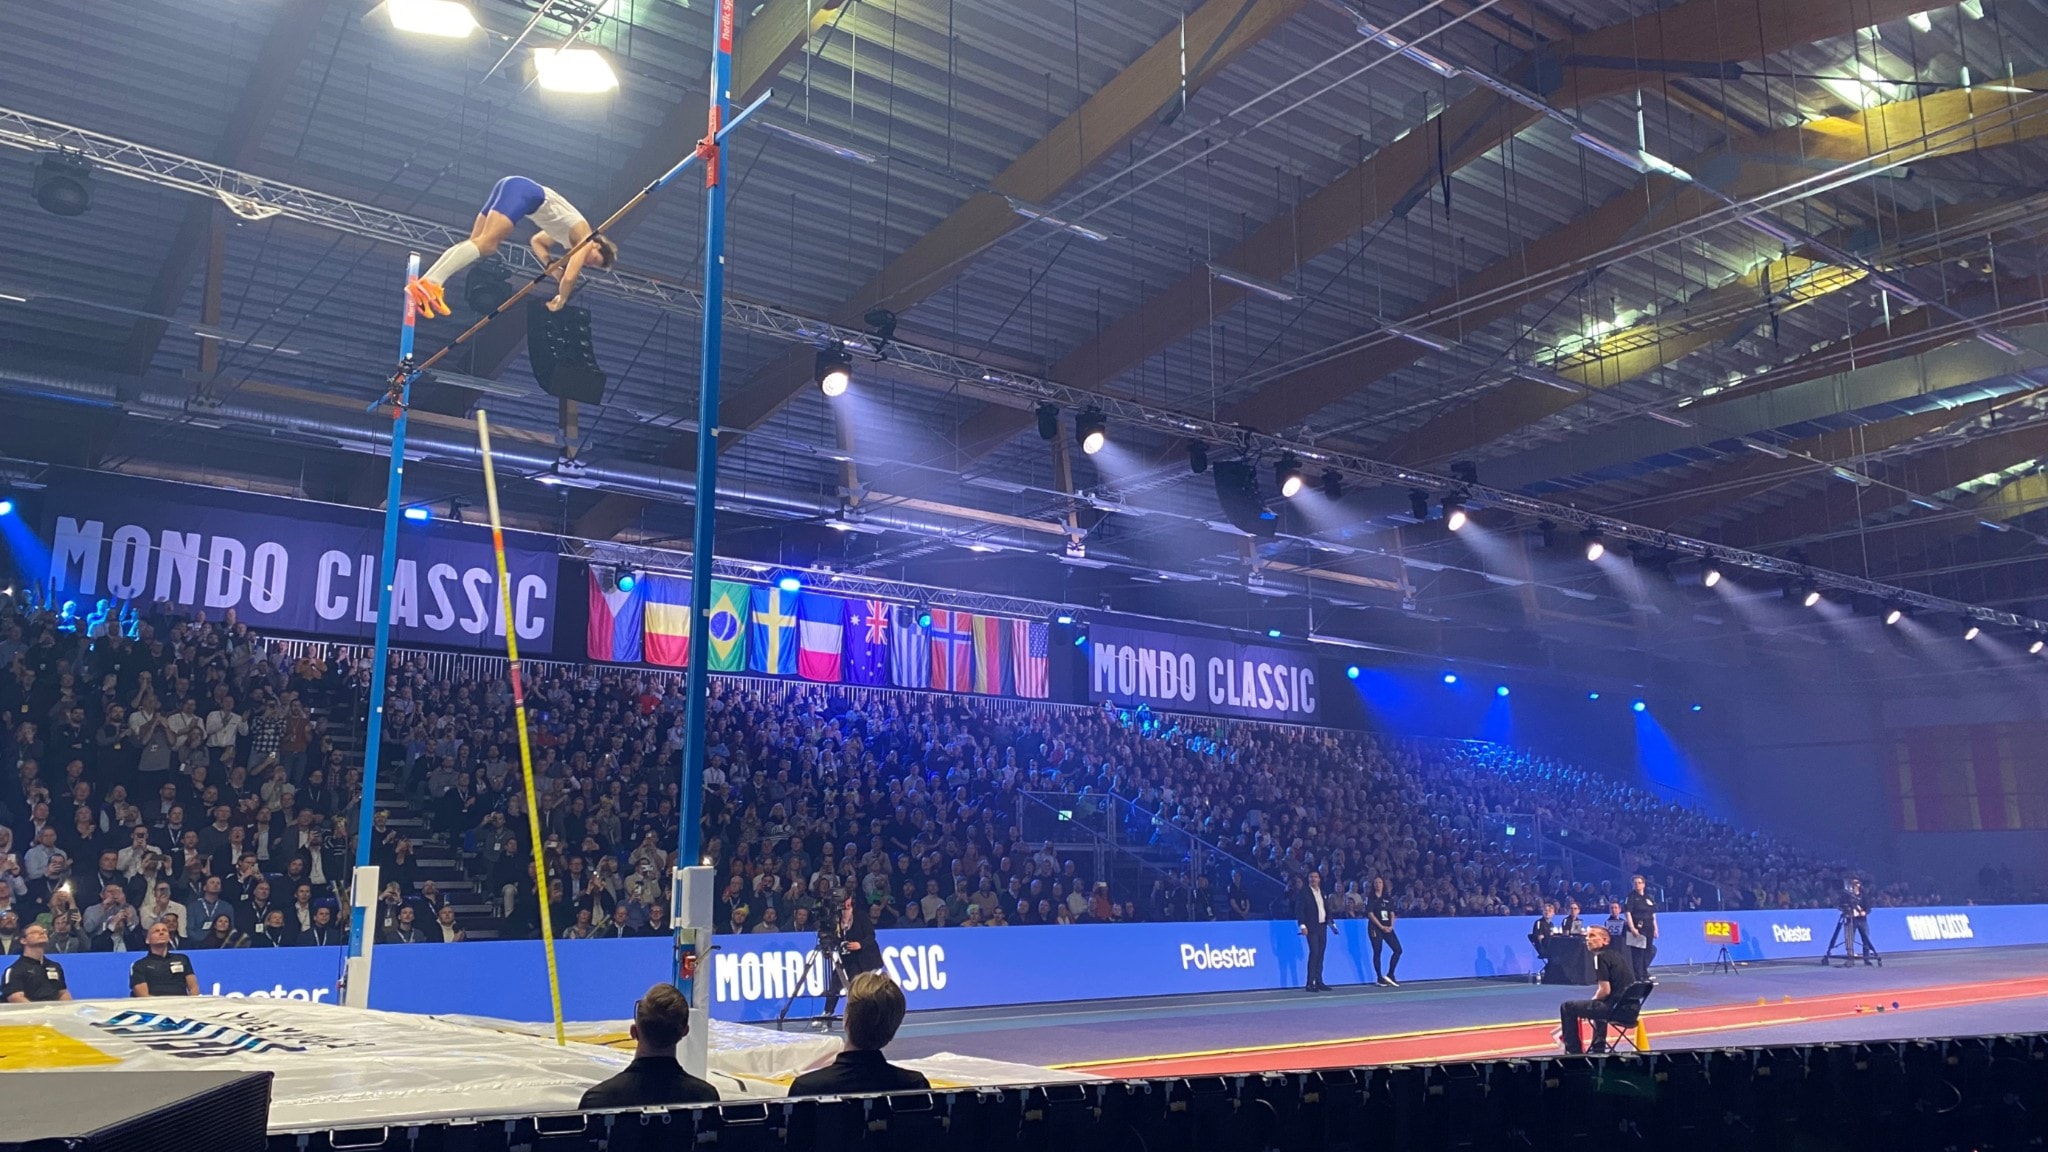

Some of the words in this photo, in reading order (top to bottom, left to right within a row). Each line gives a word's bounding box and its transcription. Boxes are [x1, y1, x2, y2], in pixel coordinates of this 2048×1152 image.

[48, 516, 288, 613] MONDO
[315, 550, 547, 640] CLASSIC
[1095, 643, 1196, 701] MONDO
[1208, 657, 1315, 714] CLASSIC
[1180, 943, 1256, 970] Polestar
[1772, 924, 1812, 942] Polestar
[715, 950, 824, 1002] MONDO
